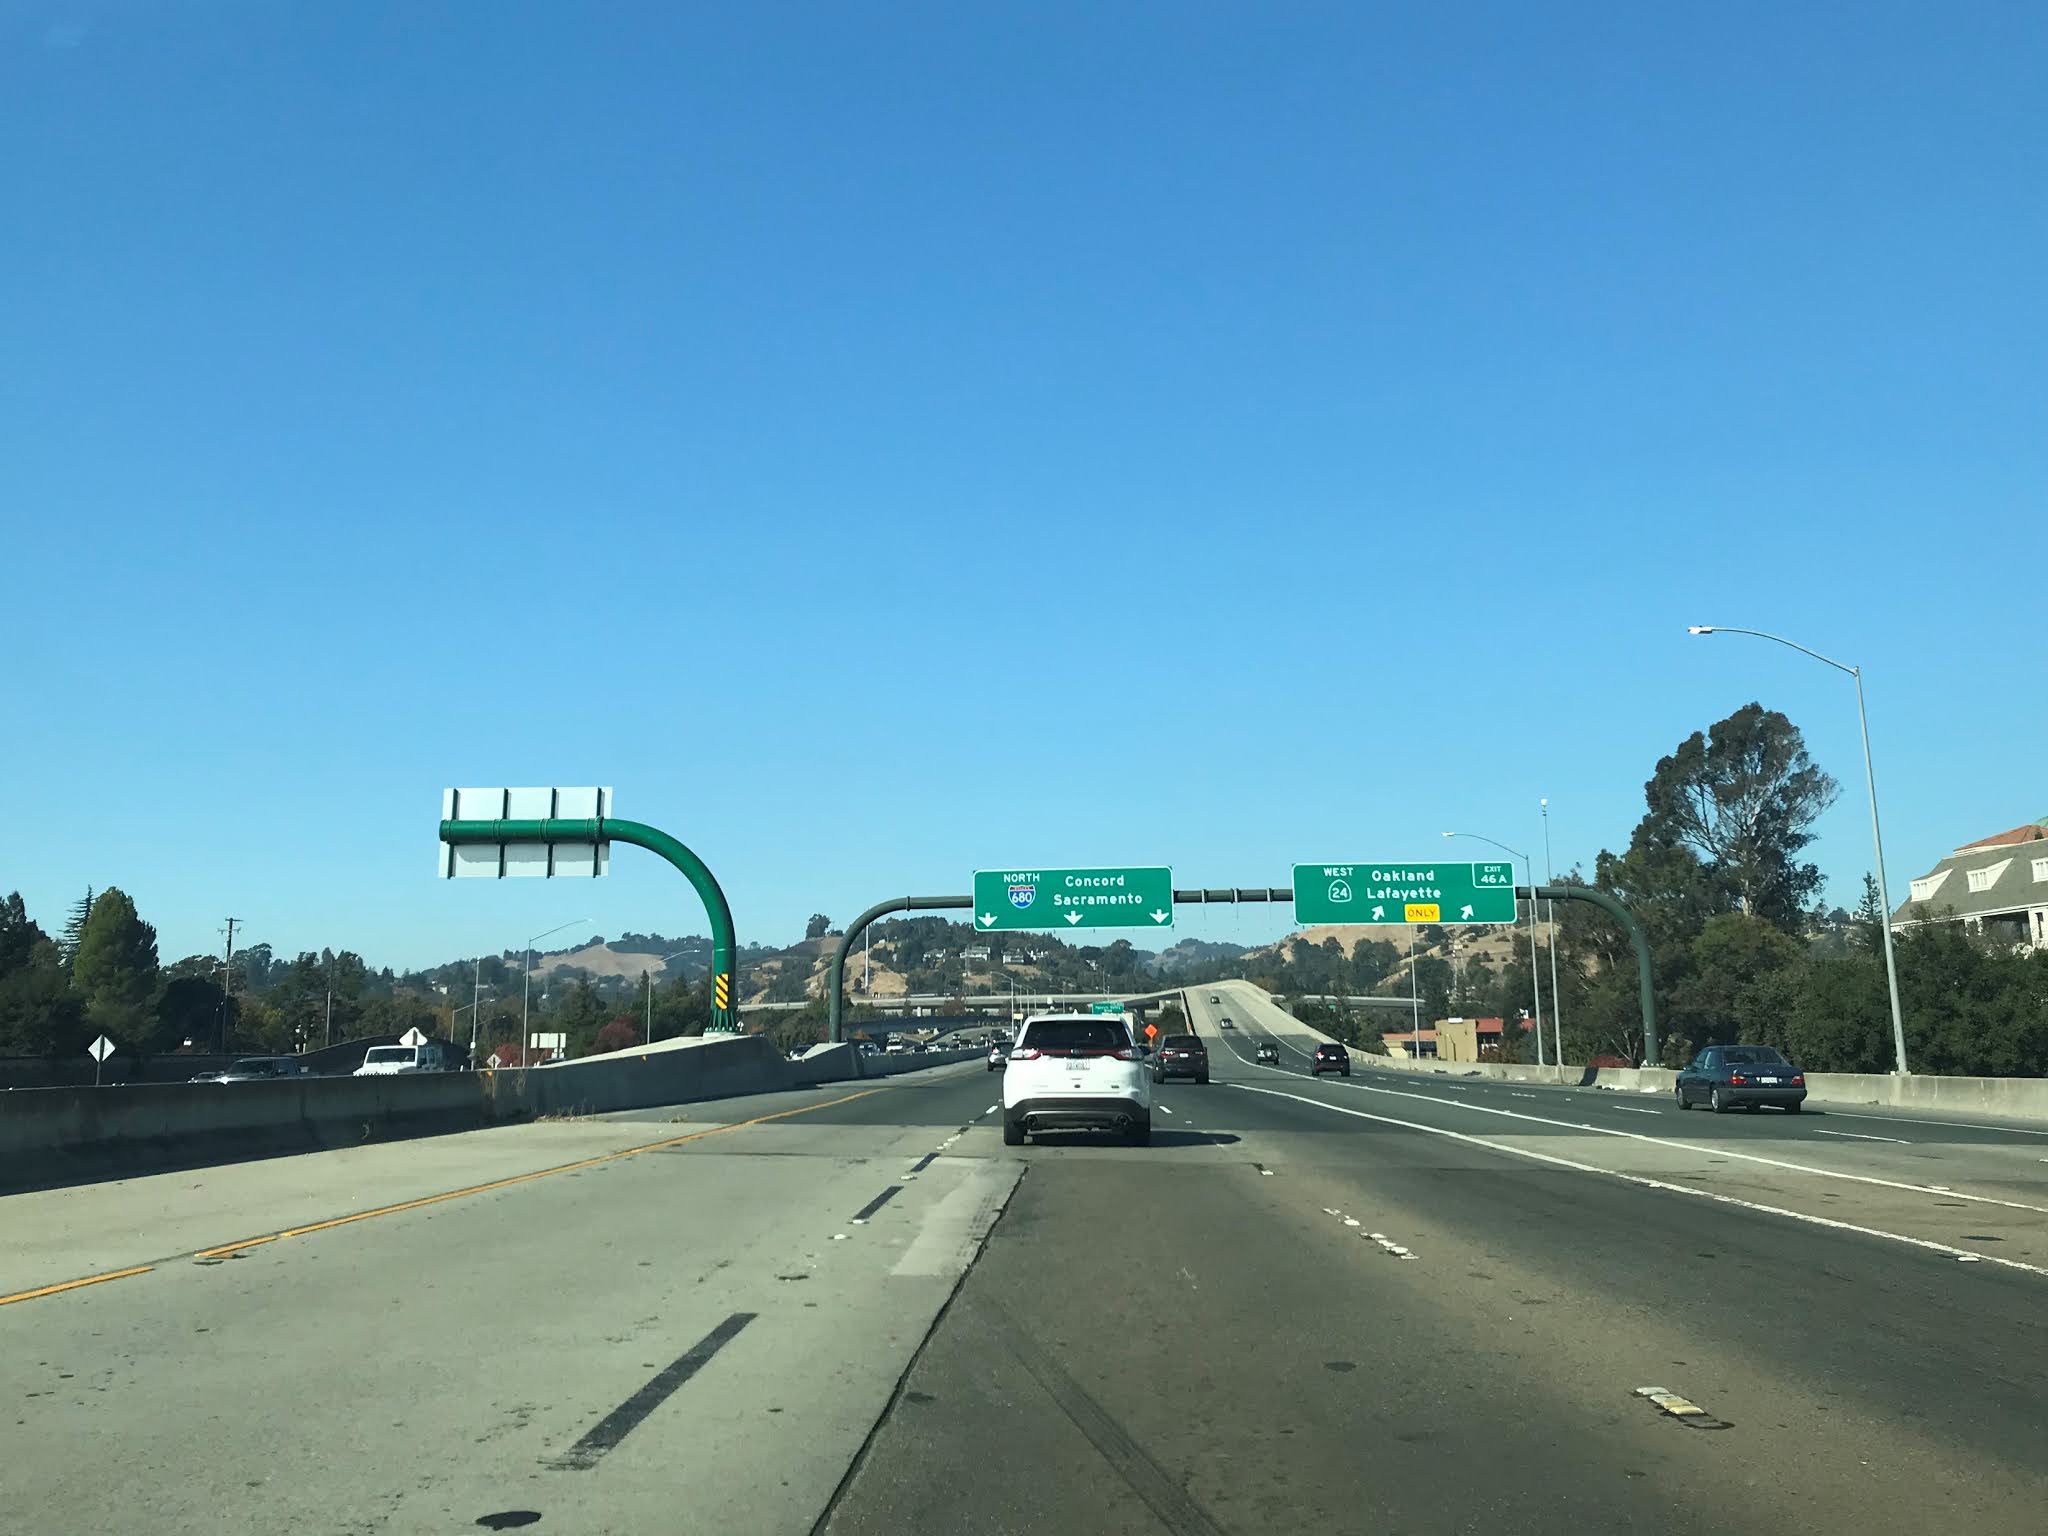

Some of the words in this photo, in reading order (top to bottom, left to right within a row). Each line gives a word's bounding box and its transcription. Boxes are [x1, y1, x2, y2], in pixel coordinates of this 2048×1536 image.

[1323, 867, 1354, 877] WEST
[1371, 870, 1435, 882] Oakland
[1003, 873, 1040, 883] NORTH
[1065, 875, 1125, 887] Concord
[1481, 875, 1497, 884] 46
[1498, 875, 1508, 884] A
[1011, 892, 1032, 903] 680
[1332, 888, 1348, 899] 24
[1366, 888, 1441, 901] Lafayette
[1054, 893, 1143, 906] Sacramento
[1407, 908, 1436, 918] ONLY
